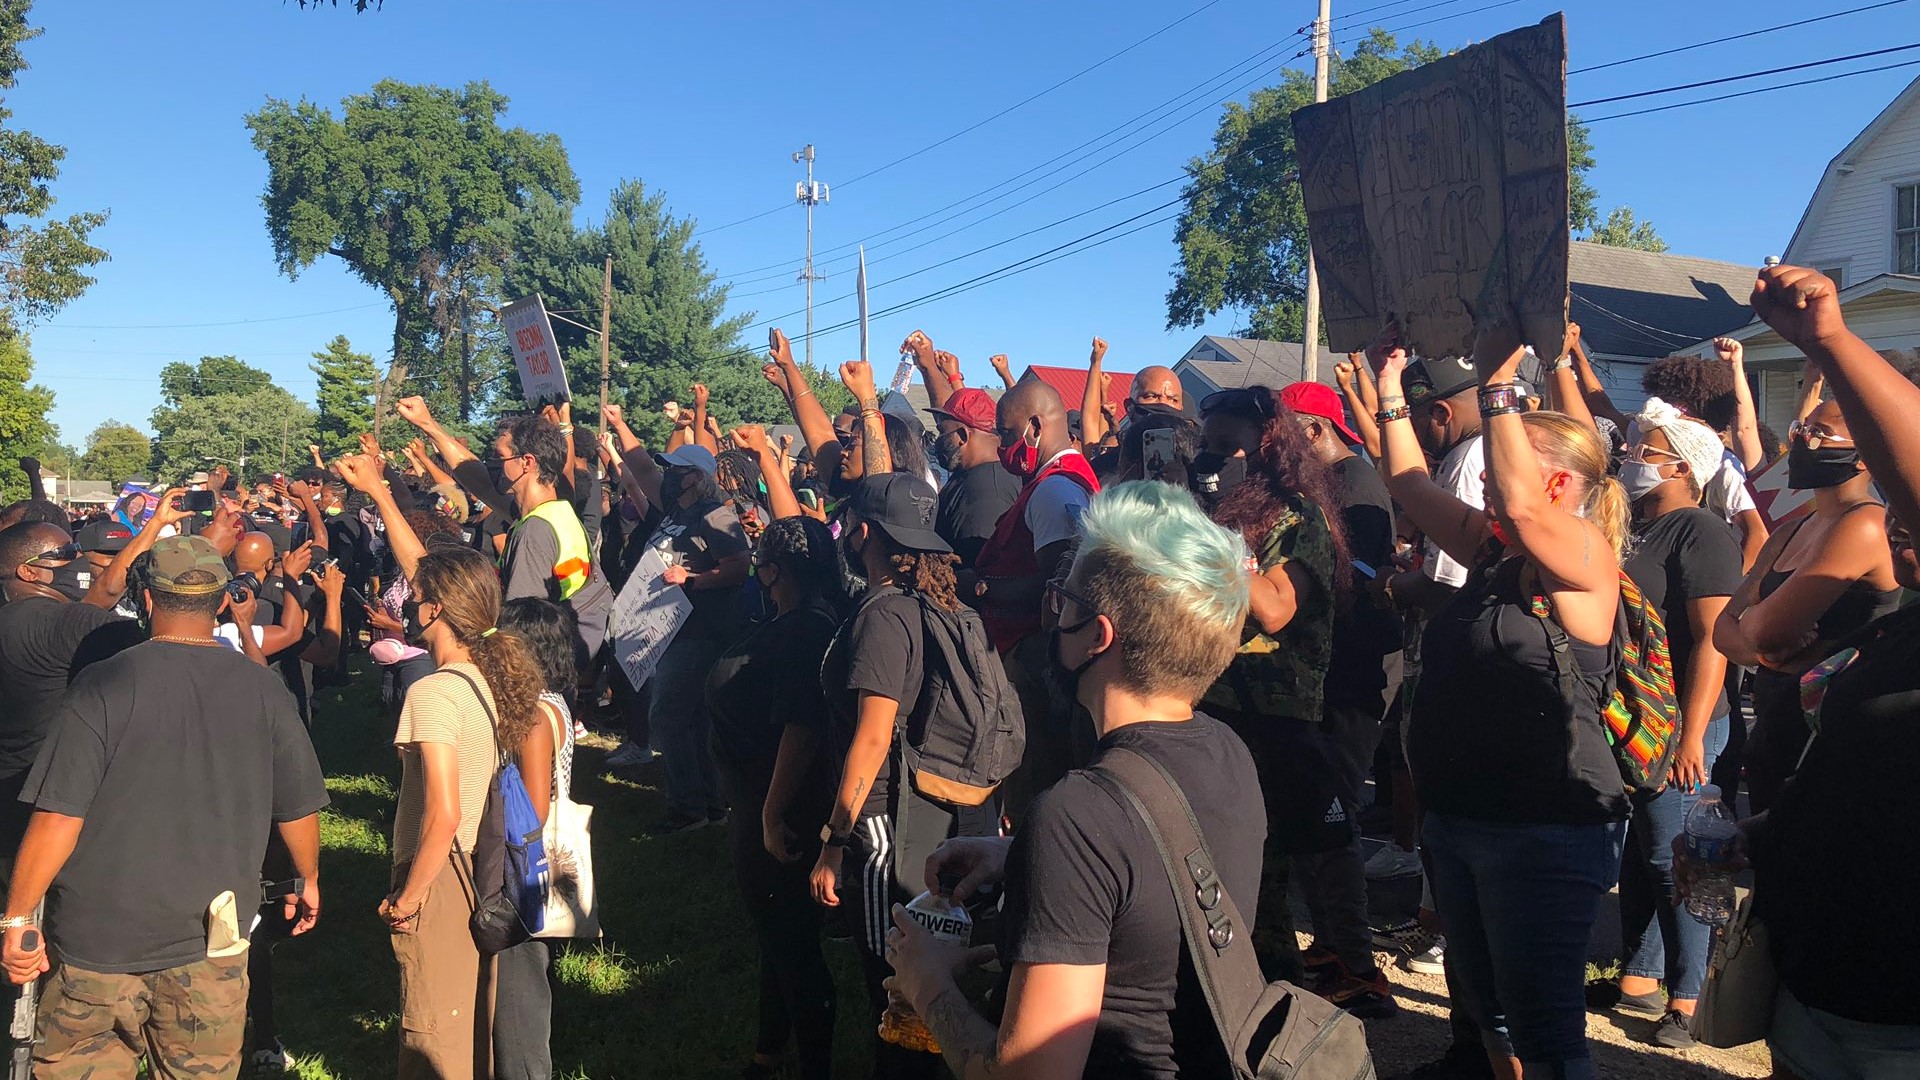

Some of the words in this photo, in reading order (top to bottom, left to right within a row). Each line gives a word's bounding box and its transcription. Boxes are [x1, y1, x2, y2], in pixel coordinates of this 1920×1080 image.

[658, 608, 669, 623] IS
[658, 603, 685, 643] WHITE
[625, 623, 658, 672] VIOLENCE
[629, 638, 662, 688] SILENCE
